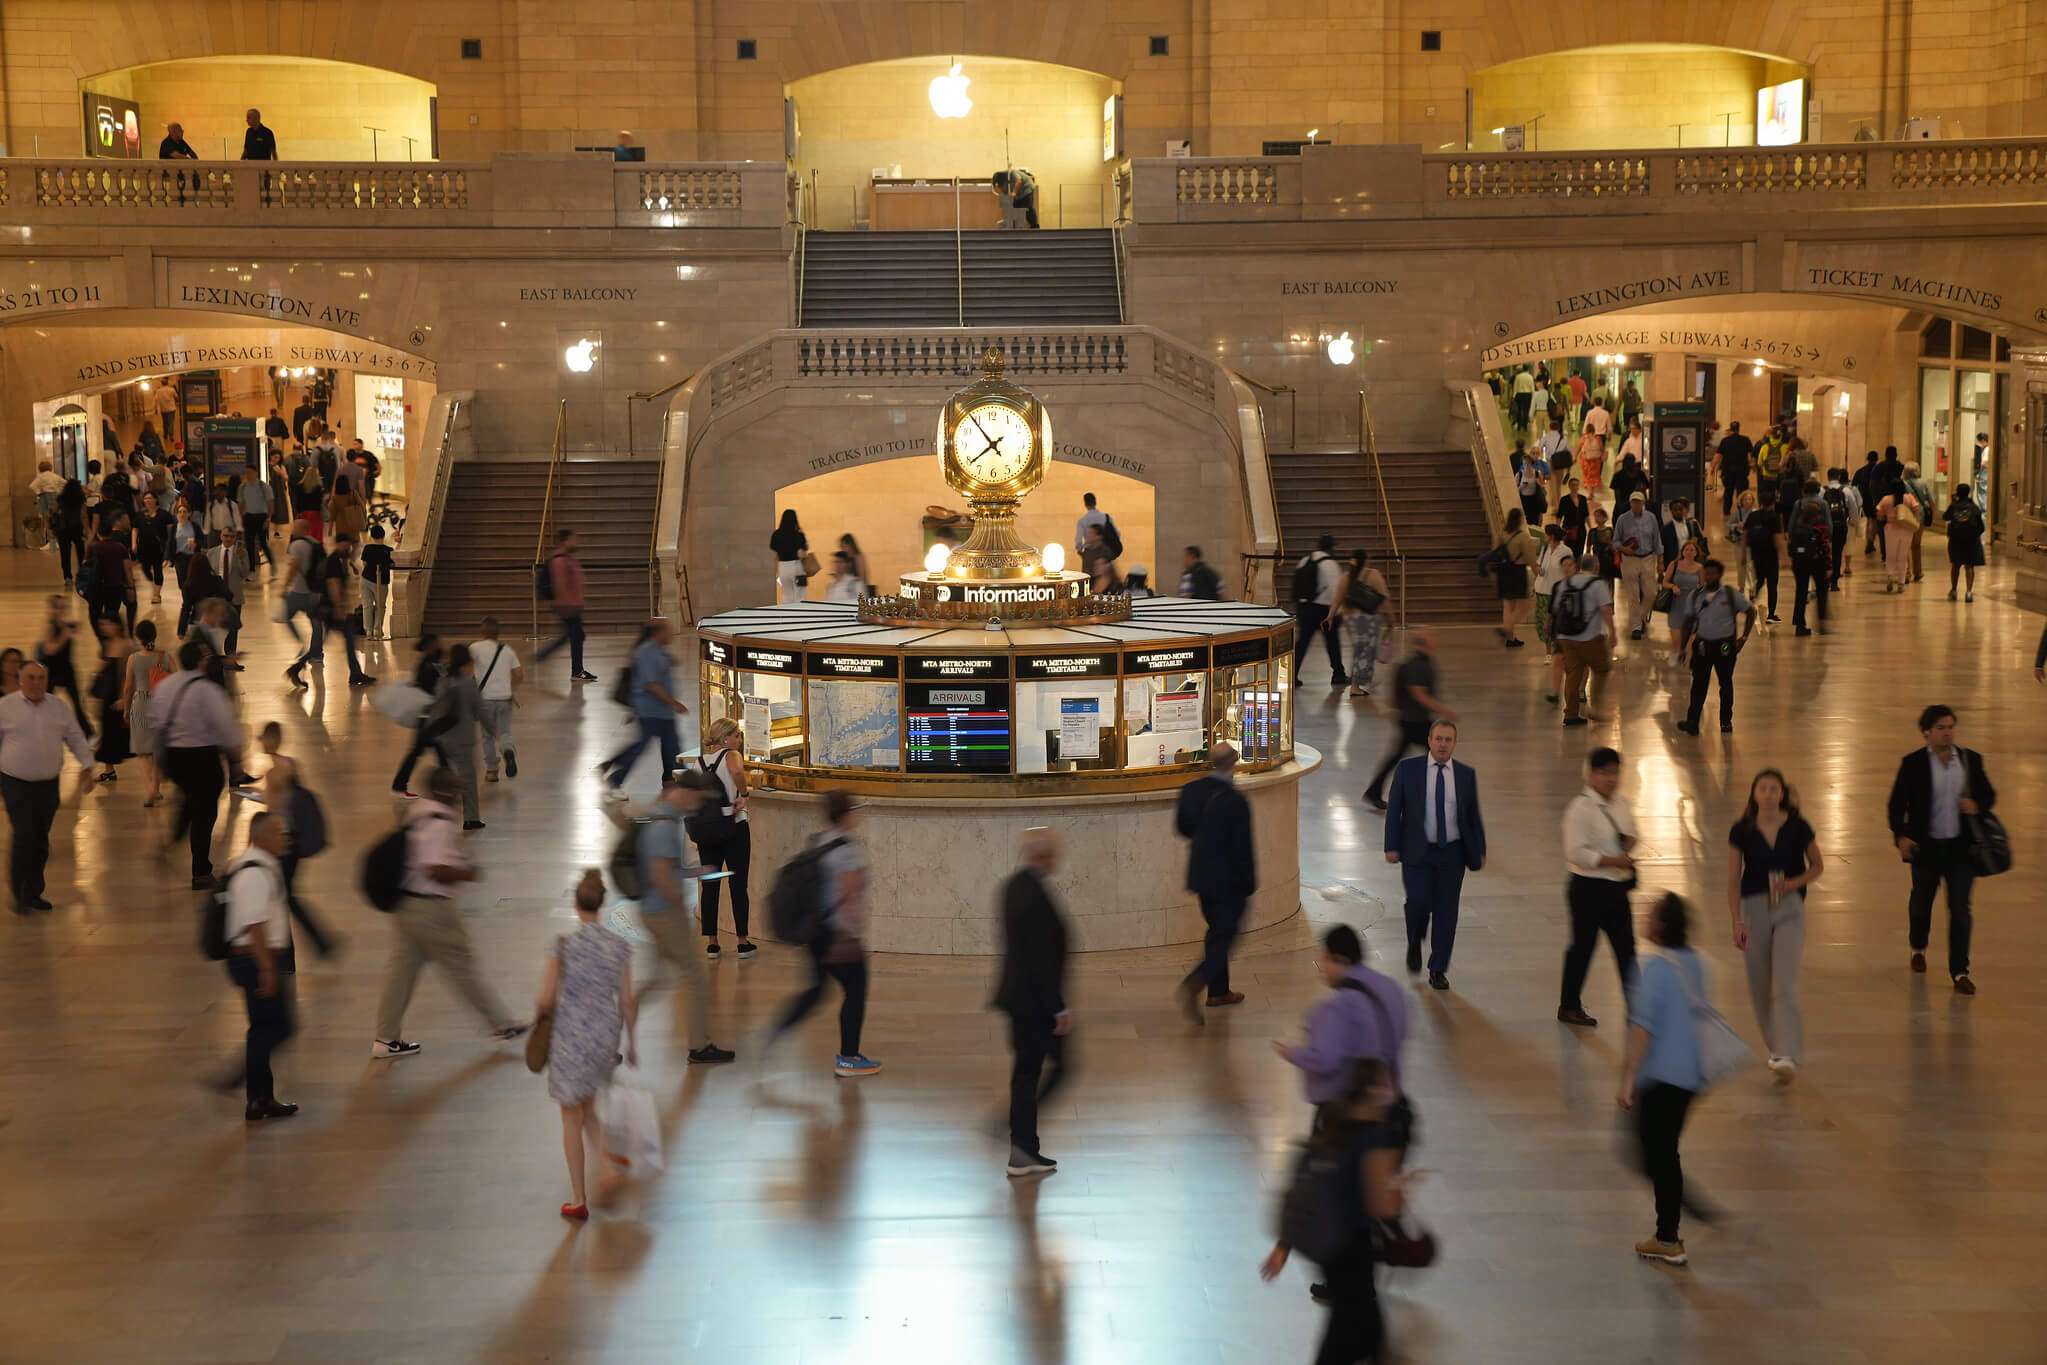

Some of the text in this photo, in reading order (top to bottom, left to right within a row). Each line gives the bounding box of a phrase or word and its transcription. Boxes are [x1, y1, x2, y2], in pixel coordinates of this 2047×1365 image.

[1282, 280, 1398, 294] EAST BALCONY
[1809, 268, 2002, 310] TICKET MACHINES
[22, 291, 42, 308] 21
[47, 287, 78, 304] TO
[85, 286, 101, 301] 11
[520, 288, 638, 300] EAST BALCONY
[1556, 270, 1730, 316] LEXINGTON AVE
[182, 286, 361, 327] LEXINGTON AVE
[1504, 336, 1568, 358] STREET
[1574, 331, 1649, 348] PASSAGE
[1659, 331, 1735, 348] SUBWAY
[77, 360, 123, 381] 42ND
[127, 350, 191, 371] STREET
[198, 346, 273, 361] PASSAGE
[290, 346, 364, 364] SUBWAY
[988, 411, 997, 421] 12
[808, 448, 861, 471] TRACKS
[864, 444, 883, 456] 100
[886, 440, 906, 452] TO
[909, 439, 926, 449] 117
[1015, 454, 1021, 464] 4
[1063, 444, 1146, 475] CONCOURSE
[977, 465, 982, 475] 7
[990, 468, 996, 478] 6
[1004, 465, 1010, 474] 5
[964, 586, 1055, 602] Information
[823, 657, 884, 667] MTA METRO-NORTH
[1049, 658, 1100, 666] METRO-NORTH
[1137, 652, 1193, 663] MTA METRO-NORTH
[834, 664, 872, 673] TIMETABLES
[1046, 665, 1087, 673] TIMETABLES
[1148, 660, 1183, 668] TIMETABLES
[933, 693, 982, 702] ARRIVALS
